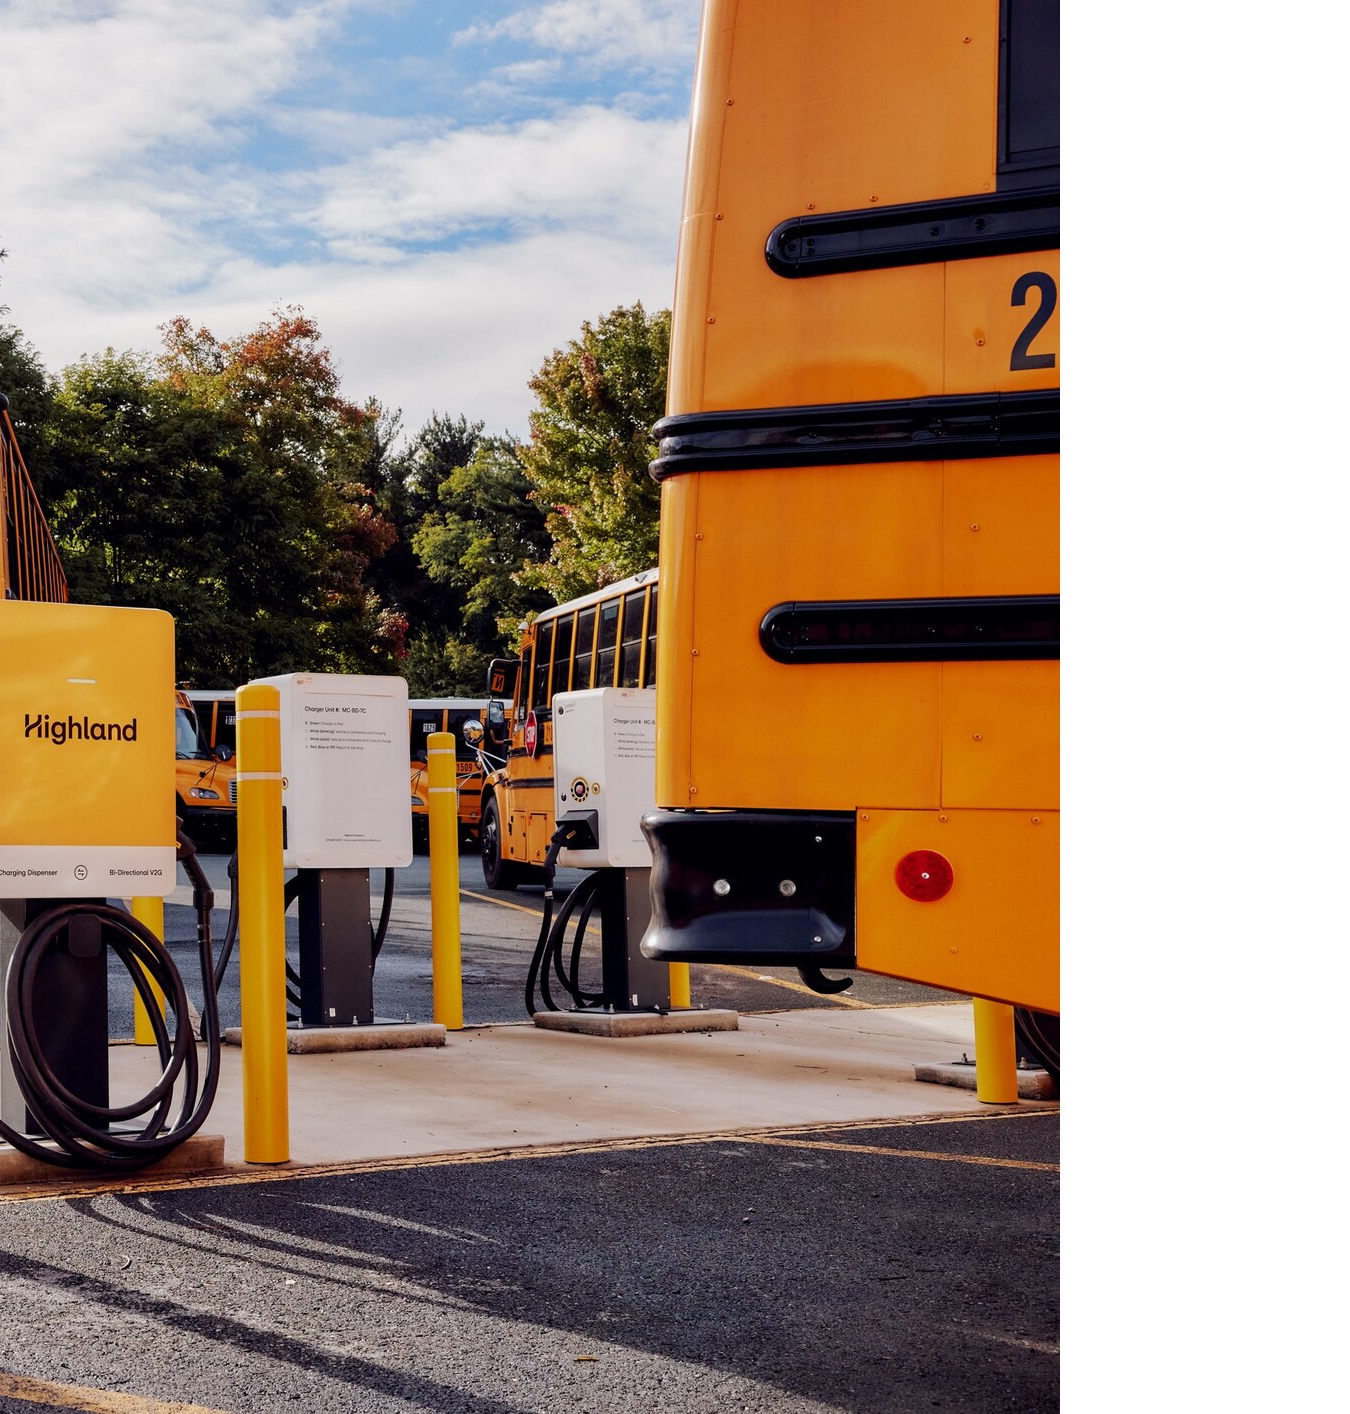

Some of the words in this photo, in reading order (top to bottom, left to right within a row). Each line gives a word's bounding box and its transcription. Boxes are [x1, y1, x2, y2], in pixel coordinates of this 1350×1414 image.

[1010, 271, 1057, 371] 2
[24, 714, 137, 745] Highland
[456, 762, 472, 772] 1509
[28, 869, 58, 877] Dispenser
